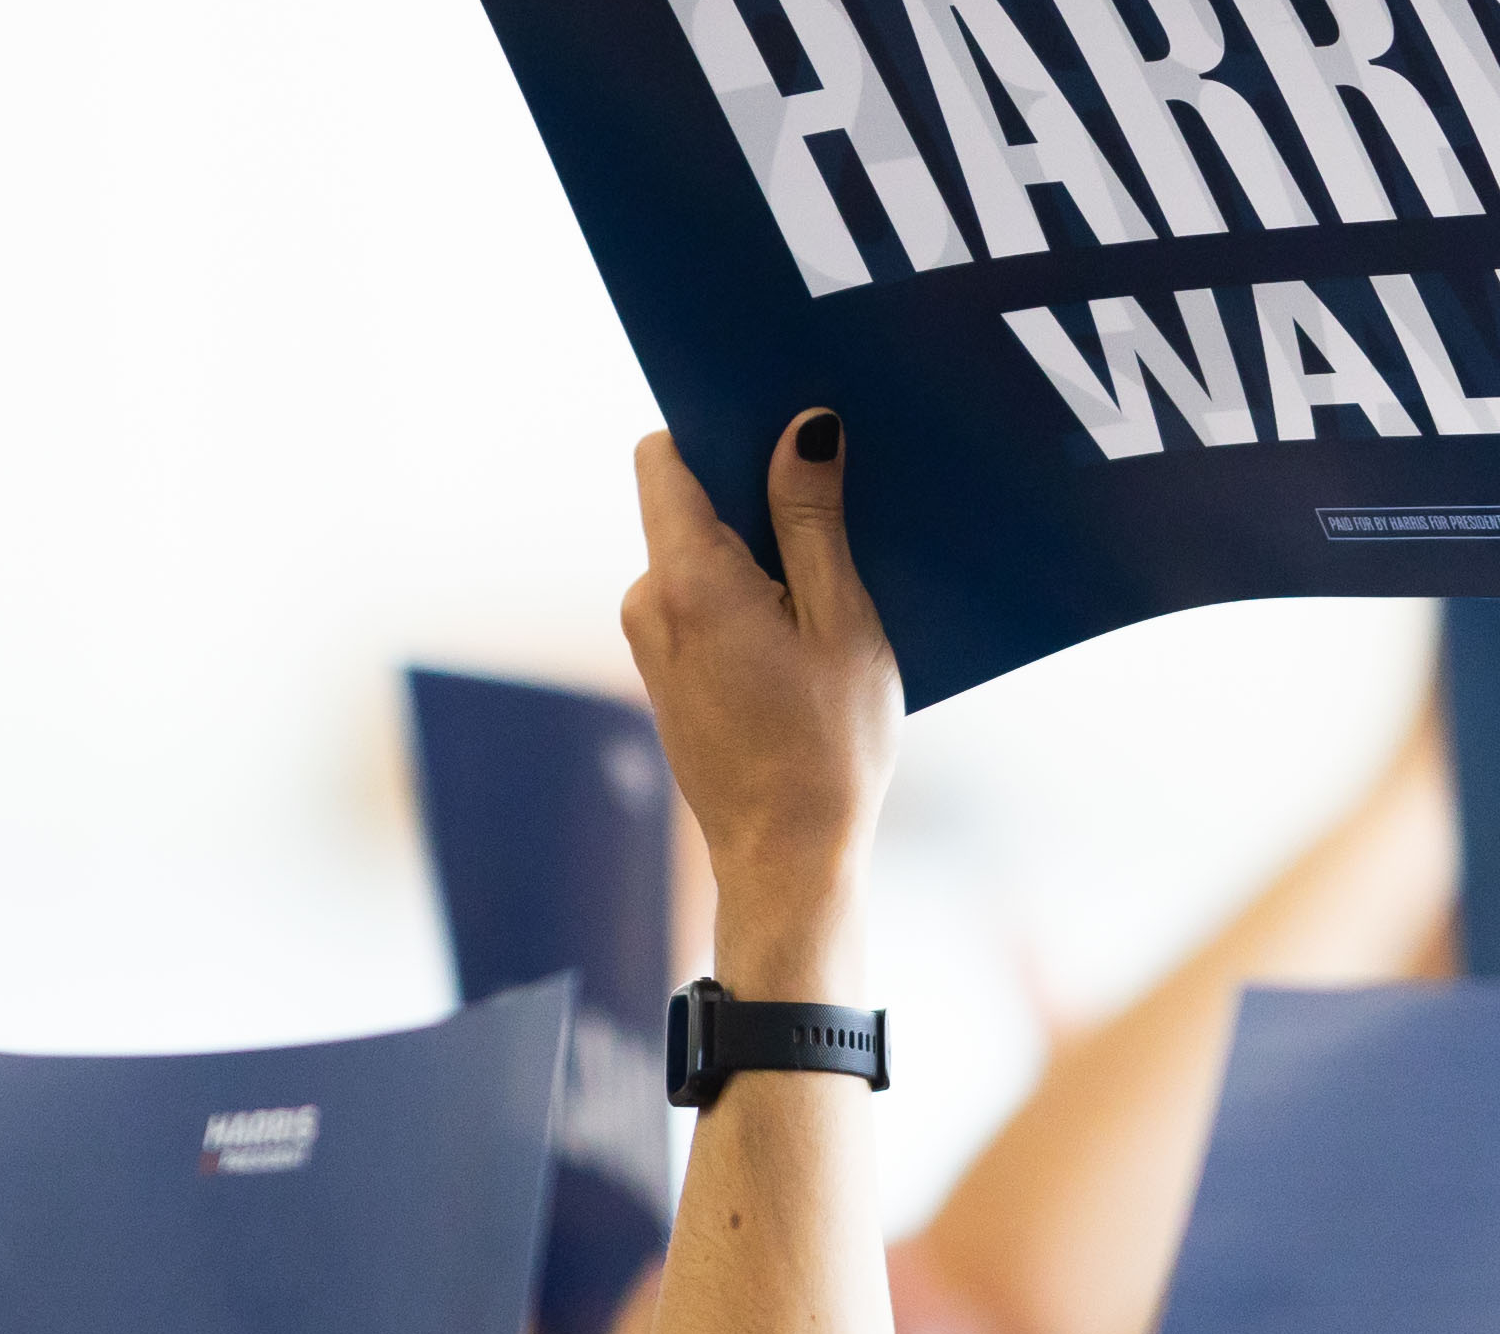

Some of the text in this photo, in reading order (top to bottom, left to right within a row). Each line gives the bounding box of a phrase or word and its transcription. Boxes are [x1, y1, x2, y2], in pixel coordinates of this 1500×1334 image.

[1328, 516, 1354, 531] PAID
[1353, 516, 1375, 531] FOR
[1373, 516, 1389, 531] BY
[1389, 515, 1430, 531] HARRIS
[1427, 515, 1450, 530] FOR
